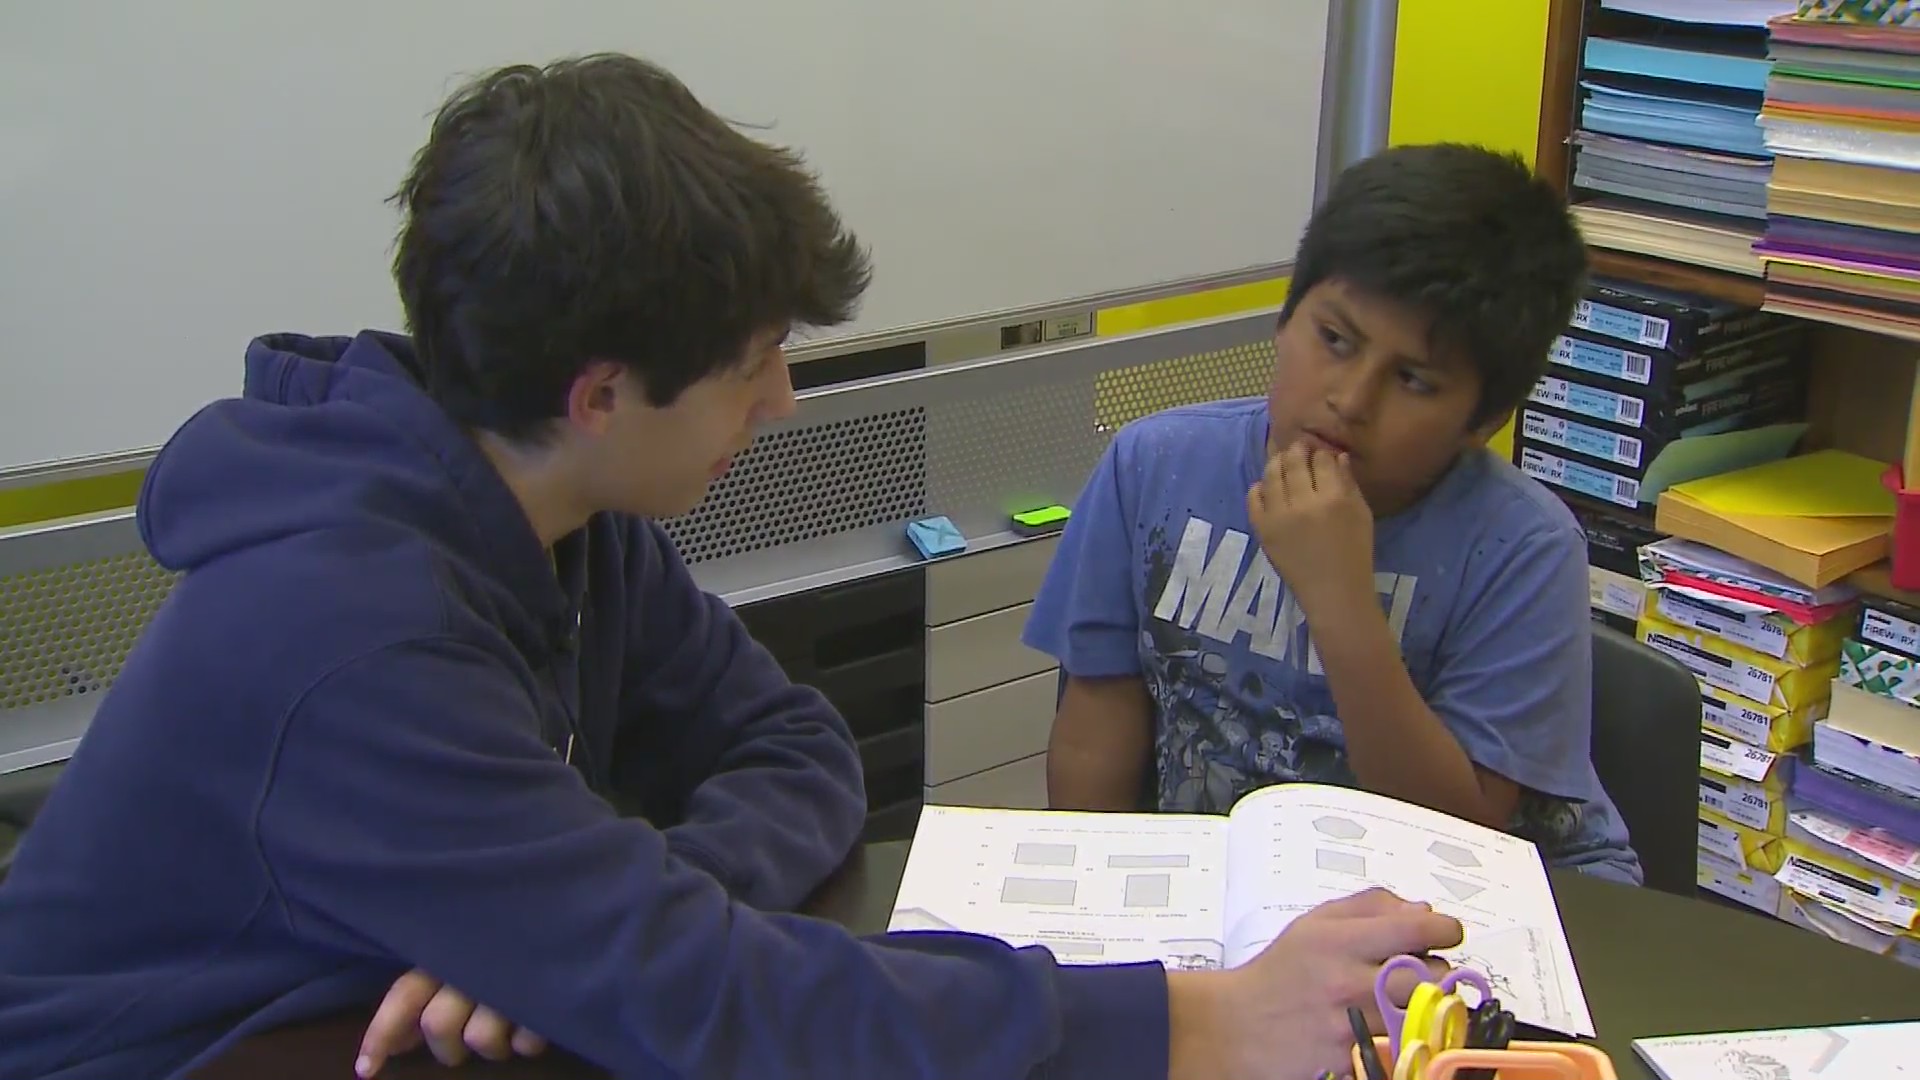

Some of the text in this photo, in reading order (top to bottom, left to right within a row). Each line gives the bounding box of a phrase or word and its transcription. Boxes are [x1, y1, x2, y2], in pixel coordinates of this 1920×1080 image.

[1747, 666, 1773, 684] 26781
[1741, 708, 1768, 726] 26781
[1744, 748, 1772, 764] 26781
[1742, 792, 1768, 810] 26781
